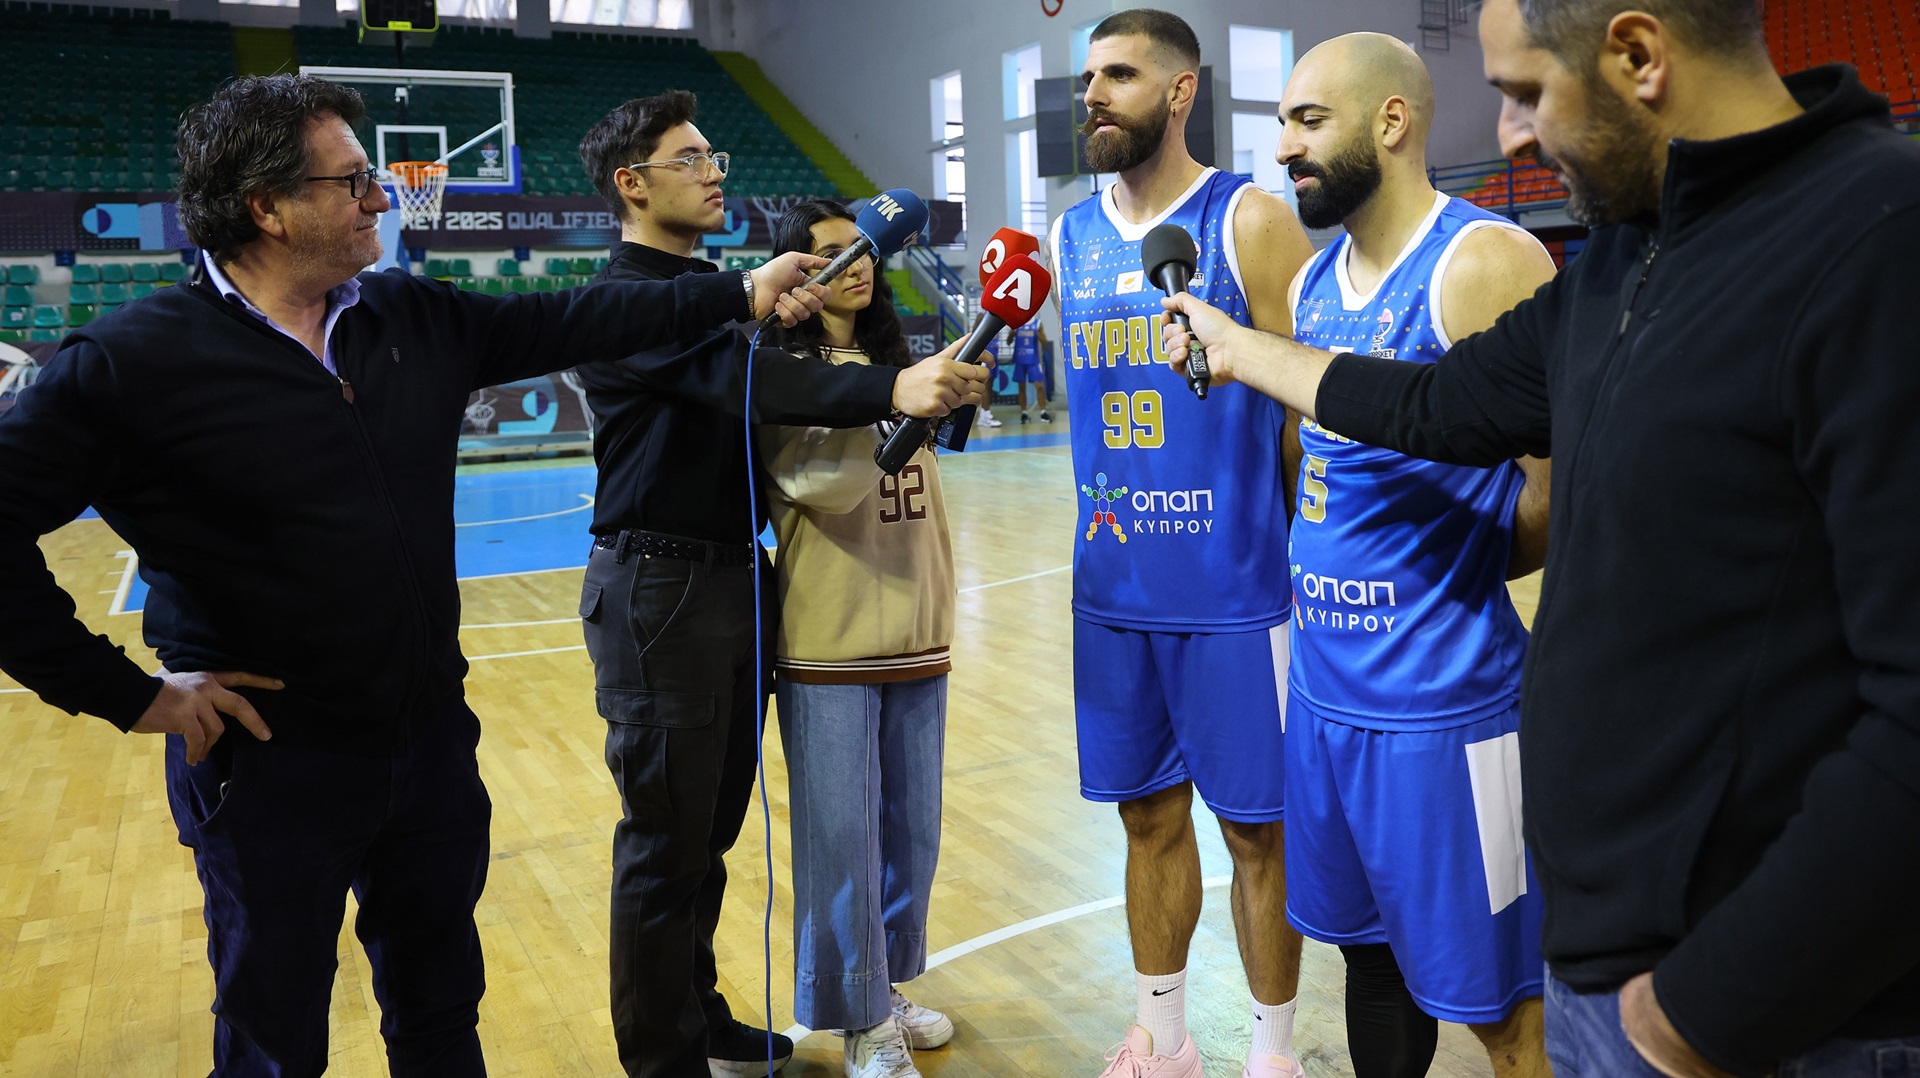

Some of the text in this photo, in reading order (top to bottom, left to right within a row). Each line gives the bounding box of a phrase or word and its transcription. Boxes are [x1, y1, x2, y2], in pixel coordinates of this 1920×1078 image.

[445, 211, 504, 231] 2025
[506, 211, 622, 230] QUALIFIER
[1069, 313, 1171, 370] CYPRU
[1101, 389, 1165, 449] 99
[878, 463, 927, 525] 92
[1300, 454, 1331, 524] 5
[1134, 519, 1213, 534] ΚΥΠΡΟΥ
[1306, 605, 1396, 633] ΚΥΠΡΟΥ
